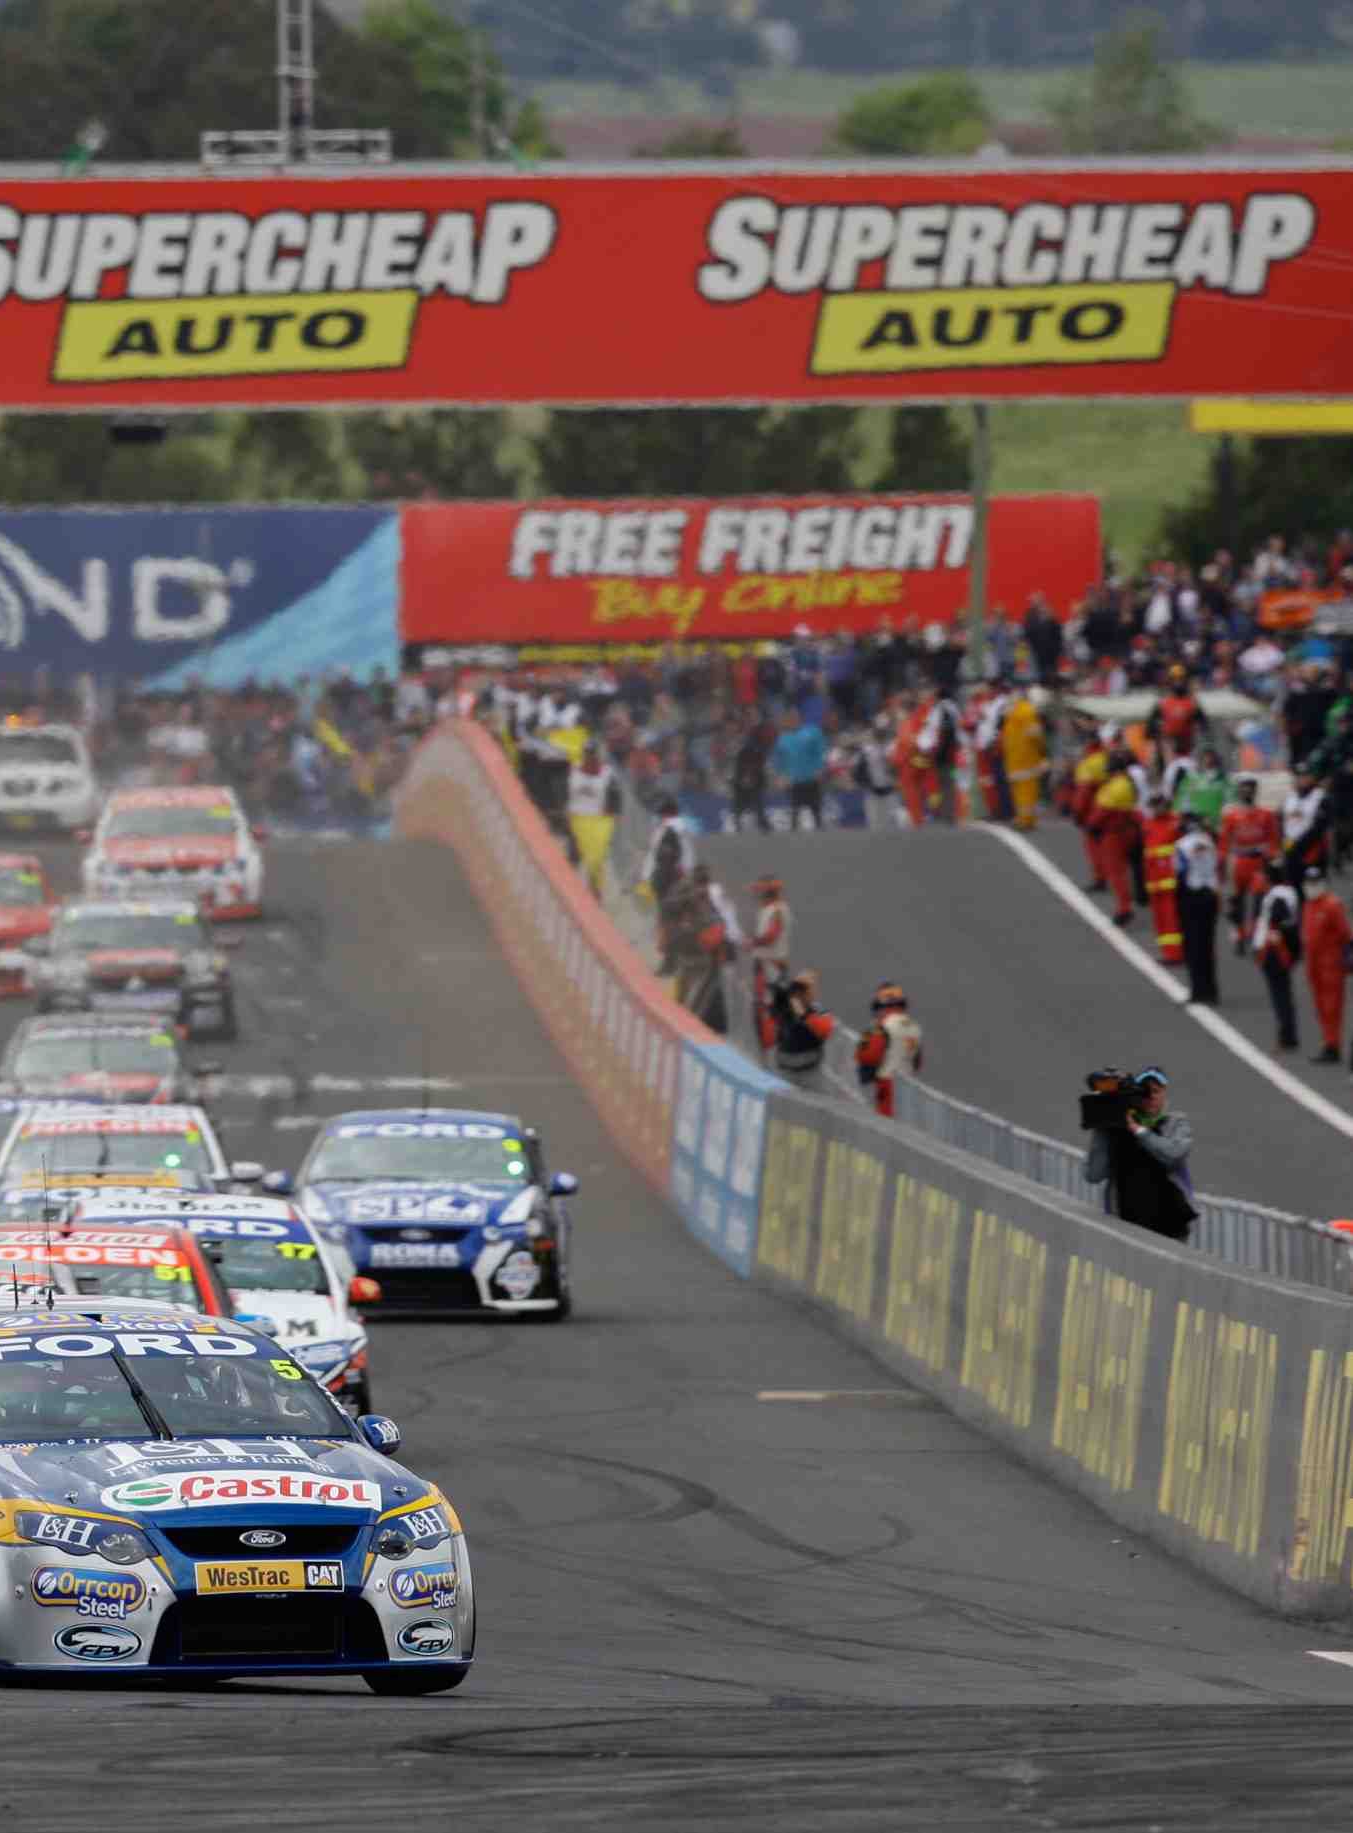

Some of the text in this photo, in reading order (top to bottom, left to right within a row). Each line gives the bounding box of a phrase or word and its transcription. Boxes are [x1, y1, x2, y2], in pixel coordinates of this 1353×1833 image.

[698, 193, 1315, 303] SUPERCHEAP
[103, 308, 367, 360] AUTO
[858, 302, 1126, 351] AUTO
[510, 508, 687, 579] FREE
[589, 576, 704, 633] Buy
[337, 1123, 507, 1137] FORD
[276, 1243, 317, 1260] 17
[154, 1265, 192, 1282] 51
[269, 1359, 302, 1380] 5
[180, 1474, 374, 1504] Castrol
[250, 1531, 276, 1544] Ford
[58, 1571, 136, 1601] Orrcon
[206, 1565, 339, 1587] WesTrac CAT
[78, 1596, 126, 1618] Steel
